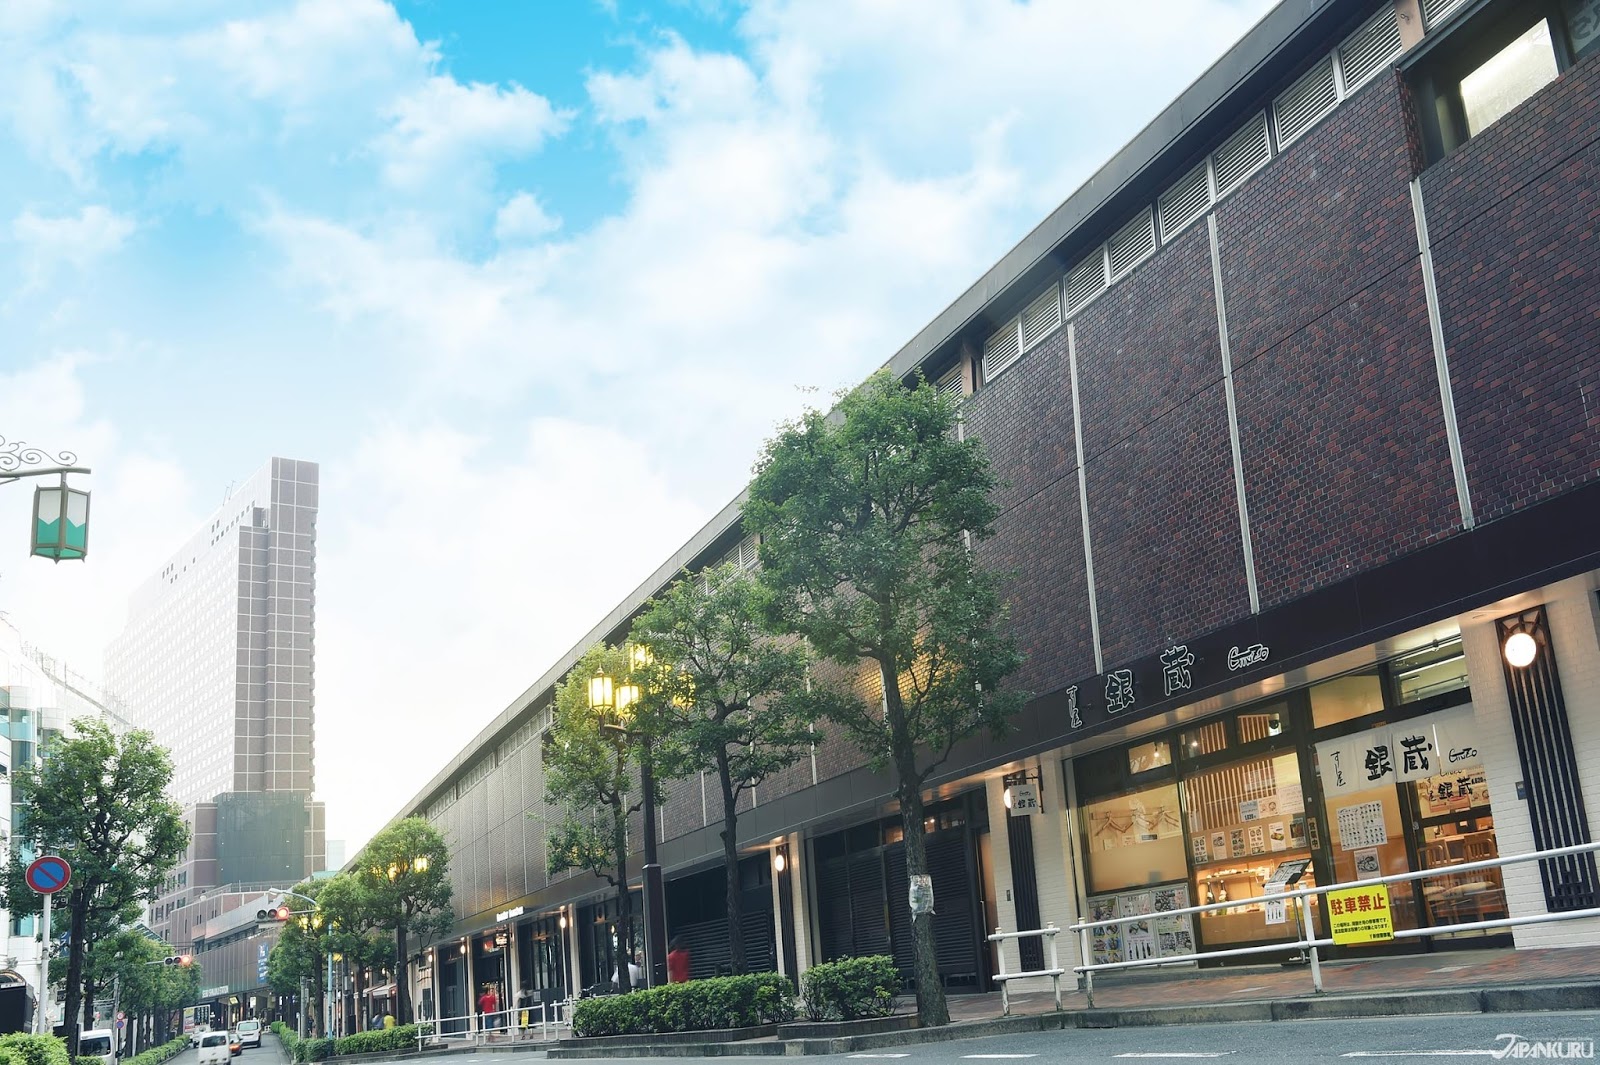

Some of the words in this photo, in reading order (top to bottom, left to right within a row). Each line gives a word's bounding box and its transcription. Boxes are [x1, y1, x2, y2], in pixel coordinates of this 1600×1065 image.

[1105, 645, 1195, 713] 銀蔵
[1364, 735, 1433, 781] 銀蔵
[1330, 892, 1387, 916] 駐車禁止
